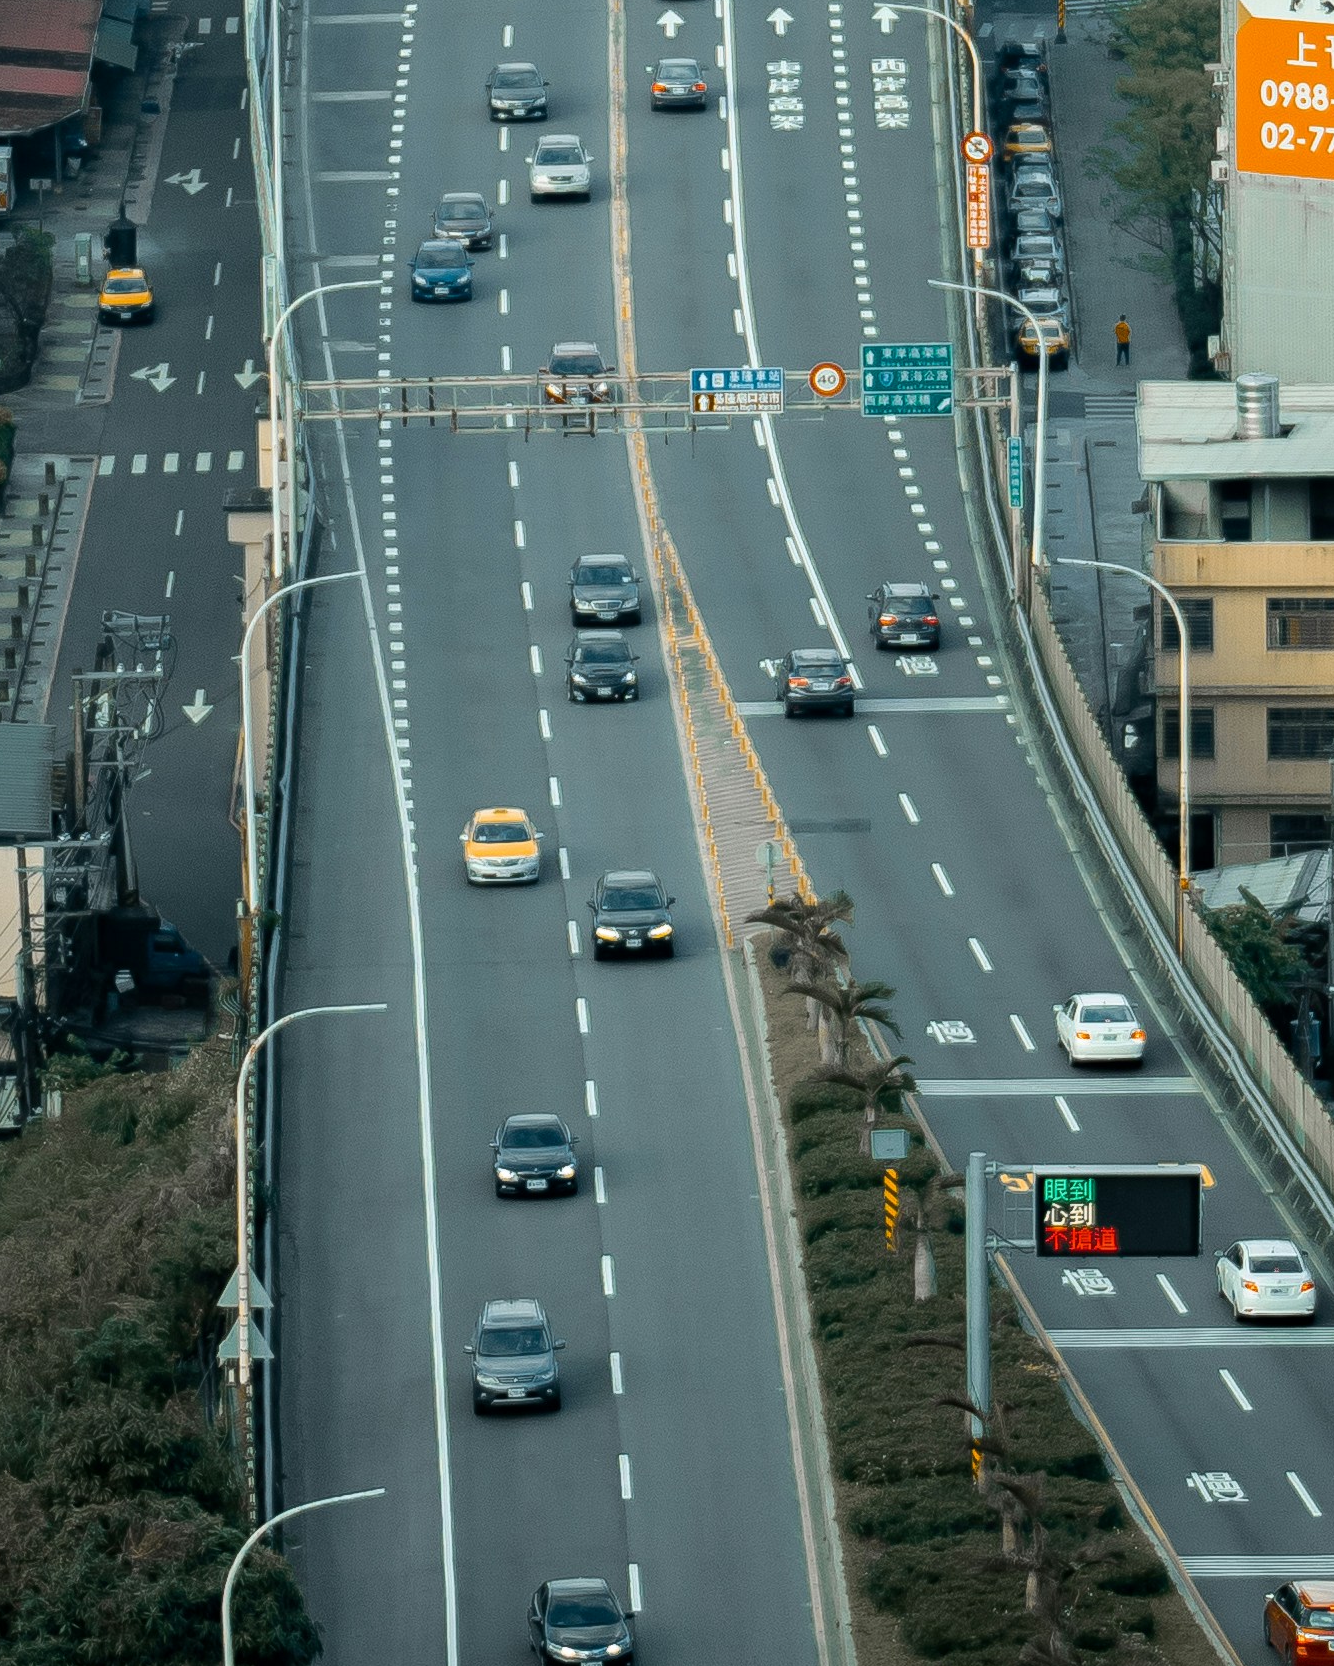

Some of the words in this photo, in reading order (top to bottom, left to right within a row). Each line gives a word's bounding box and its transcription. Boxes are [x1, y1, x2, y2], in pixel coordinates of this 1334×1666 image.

[817, 375, 837, 385] 40
[1044, 1178, 1094, 1202] 眼到
[1044, 1203, 1094, 1226] 心到
[1044, 1227, 1118, 1252] 不搶道
[1061, 1269, 1116, 1296] 慢
[1186, 1471, 1248, 1503] 慢
